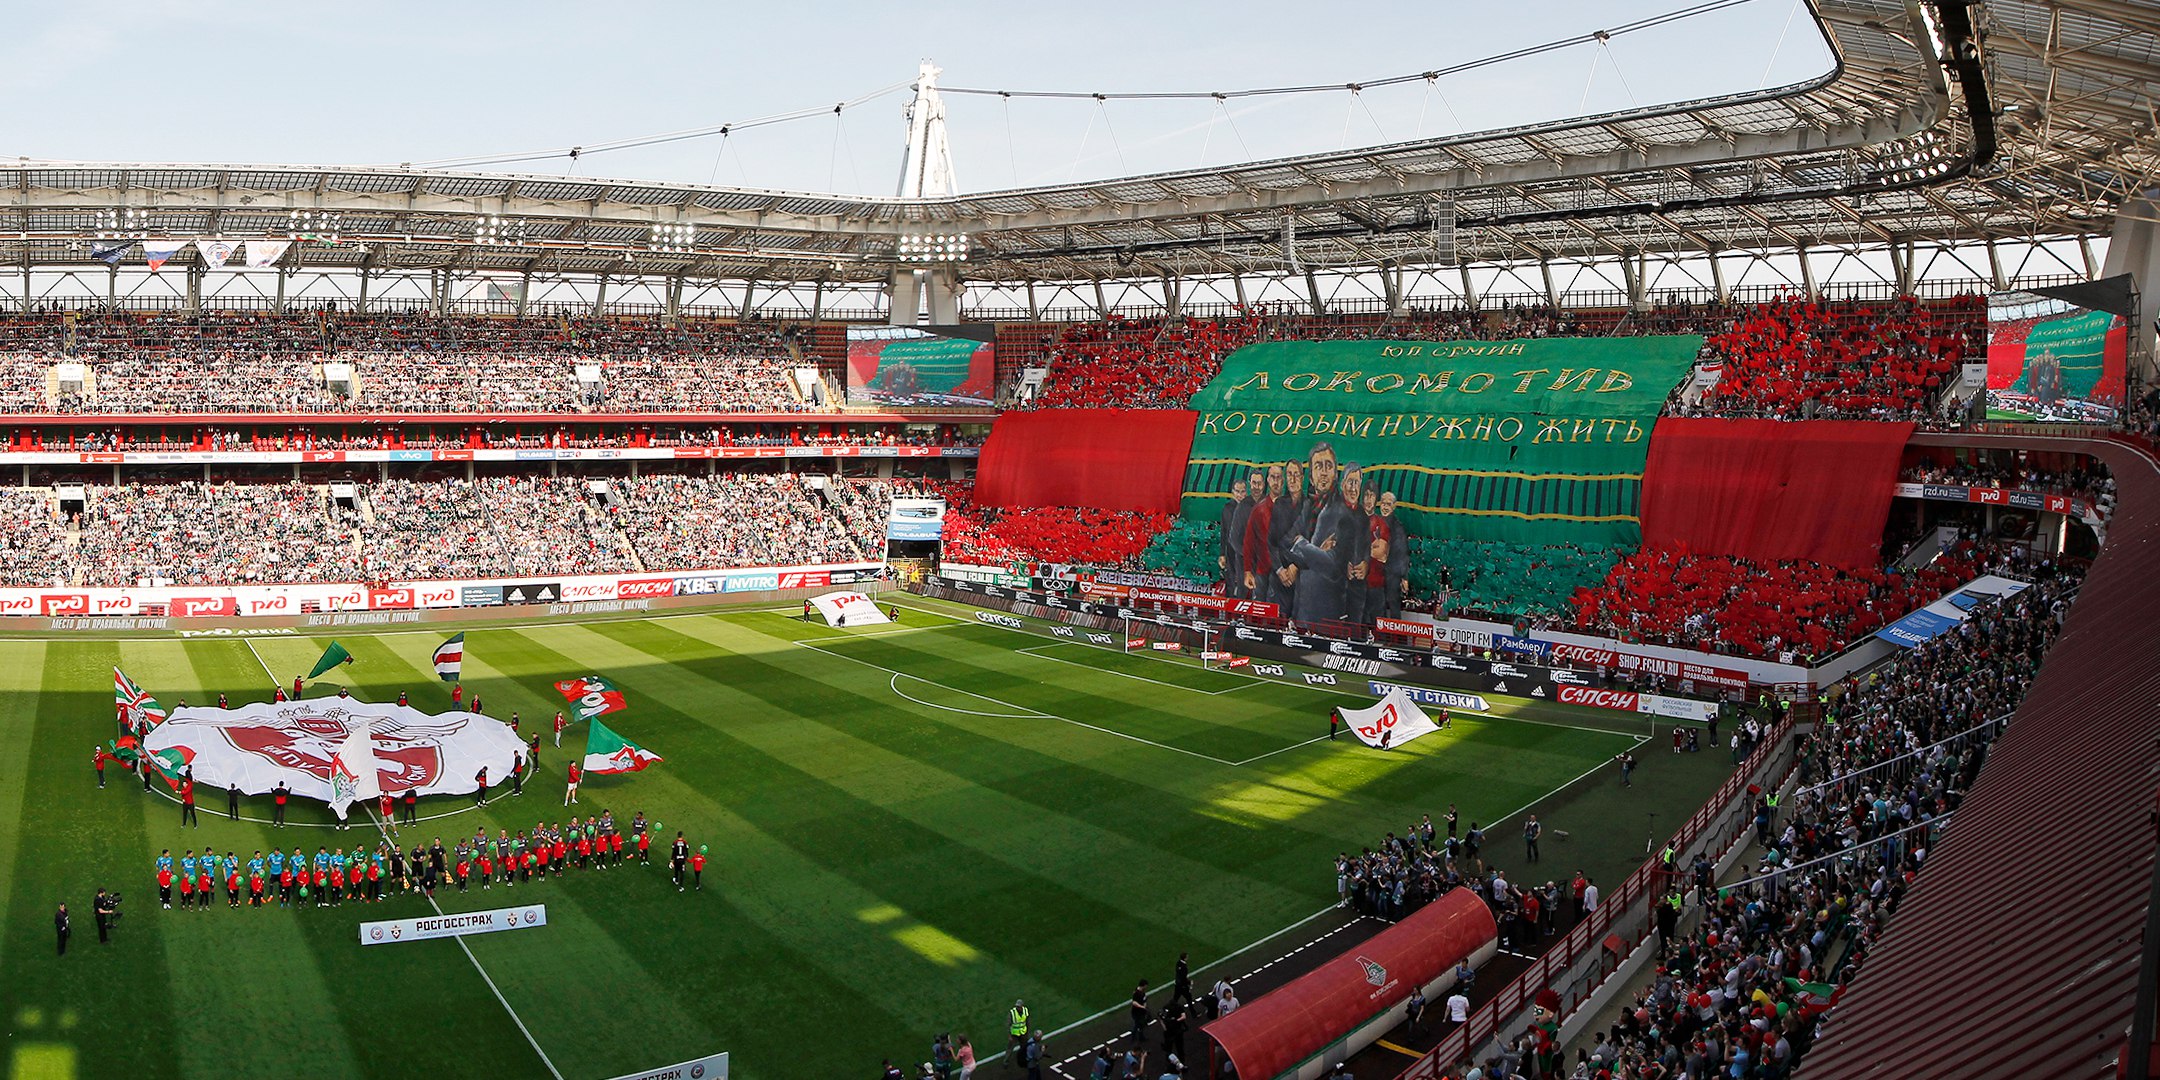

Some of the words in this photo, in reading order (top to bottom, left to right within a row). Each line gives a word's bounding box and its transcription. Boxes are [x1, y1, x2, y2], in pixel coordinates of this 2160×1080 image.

[1432, 343, 1526, 357] СЕМИН
[1230, 367, 1634, 396] ЛОКОМОТИВ
[1200, 411, 1374, 438] КОТОРЫМ
[1378, 415, 1524, 442] НУЖНО
[1532, 418, 1643, 444] ЖИТЬ
[1924, 486, 1949, 497] rzd.ru
[2009, 494, 2028, 504] rzd.ru
[618, 579, 673, 596] САПСАН
[728, 573, 777, 590] INVITRO
[561, 584, 615, 598] САПСАН
[1183, 594, 1225, 608] ЧЕМПИОНАТ
[237, 627, 294, 636] АРЕНА
[1383, 621, 1433, 636] ЧЕМПИОНАТ
[1450, 628, 1476, 645] СПОРТ
[1478, 632, 1491, 648] FM
[1554, 643, 1613, 664] САПСАН
[1322, 653, 1381, 676] SHOP.FCLM.RU
[1618, 653, 1679, 677] SHOP.FCLM.RU
[1683, 663, 1701, 673] МЕСТО
[1702, 666, 1715, 675] ДЛЯ
[1683, 671, 1719, 684] ПРАВИЛЬНЫХ
[1719, 677, 1747, 688] ПОКУПОК!
[1373, 683, 1421, 701] 1XET
[1425, 690, 1475, 709] СТАВКИ
[1560, 686, 1636, 709] САПСАН
[416, 914, 493, 932] РОСГОССТРАХ
